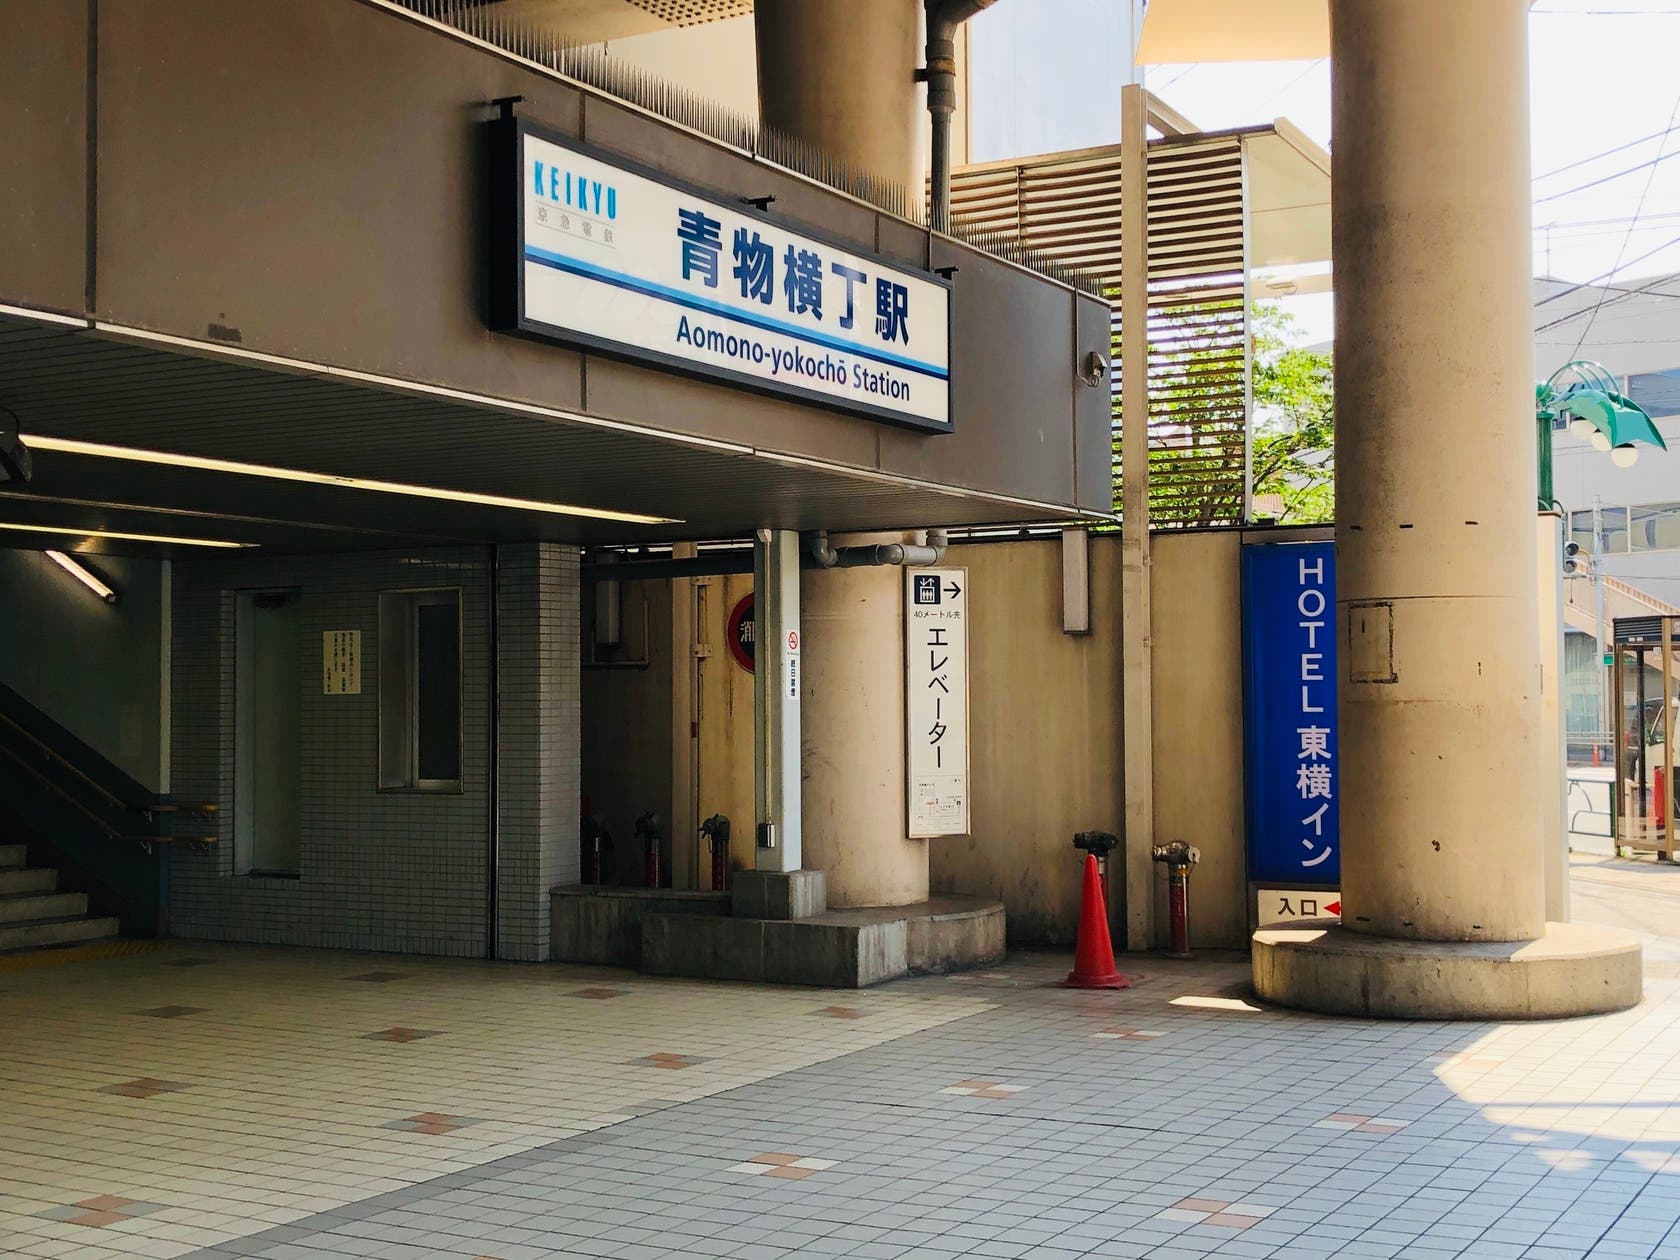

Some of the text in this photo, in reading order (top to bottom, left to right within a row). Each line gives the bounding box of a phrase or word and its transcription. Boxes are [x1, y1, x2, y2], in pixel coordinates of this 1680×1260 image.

[533, 160, 617, 219] KEIKYU
[677, 207, 909, 347] 青物横丁駅
[676, 315, 910, 401] Aomono-yokochō Station
[740, 621, 755, 643] 消
[914, 610, 961, 619] 40メートル先
[927, 628, 949, 768] エレベーター
[1296, 558, 1332, 867] HOTEL 東横イン
[1278, 897, 1317, 917] 入口
